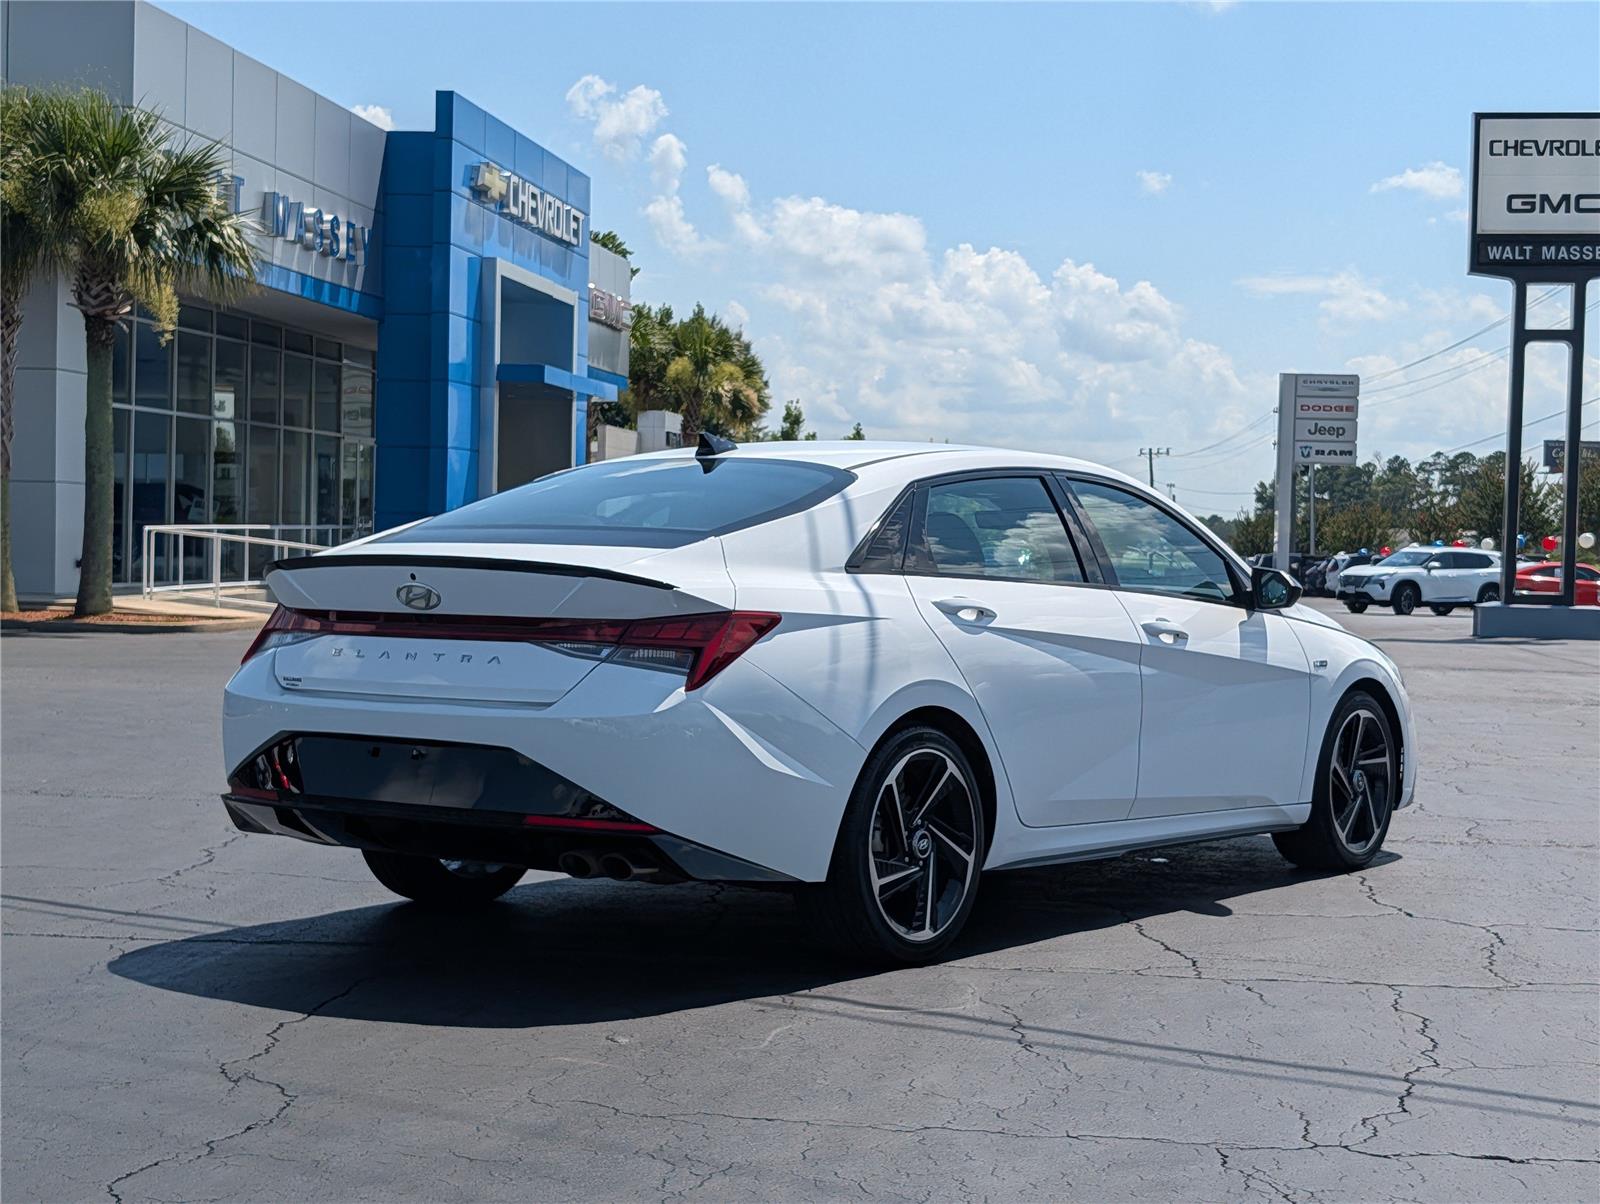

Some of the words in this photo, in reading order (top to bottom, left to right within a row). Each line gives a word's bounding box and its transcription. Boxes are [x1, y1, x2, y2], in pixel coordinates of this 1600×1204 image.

[509, 174, 585, 248] CHEVROLET
[1506, 193, 1600, 214] GMC
[263, 191, 372, 266] MASSEY
[1487, 245, 1533, 261] WALT
[1300, 404, 1355, 413] DODGE
[1307, 422, 1346, 438] Jeep
[1314, 449, 1354, 457] RAM
[331, 647, 502, 665] ELANTRA
